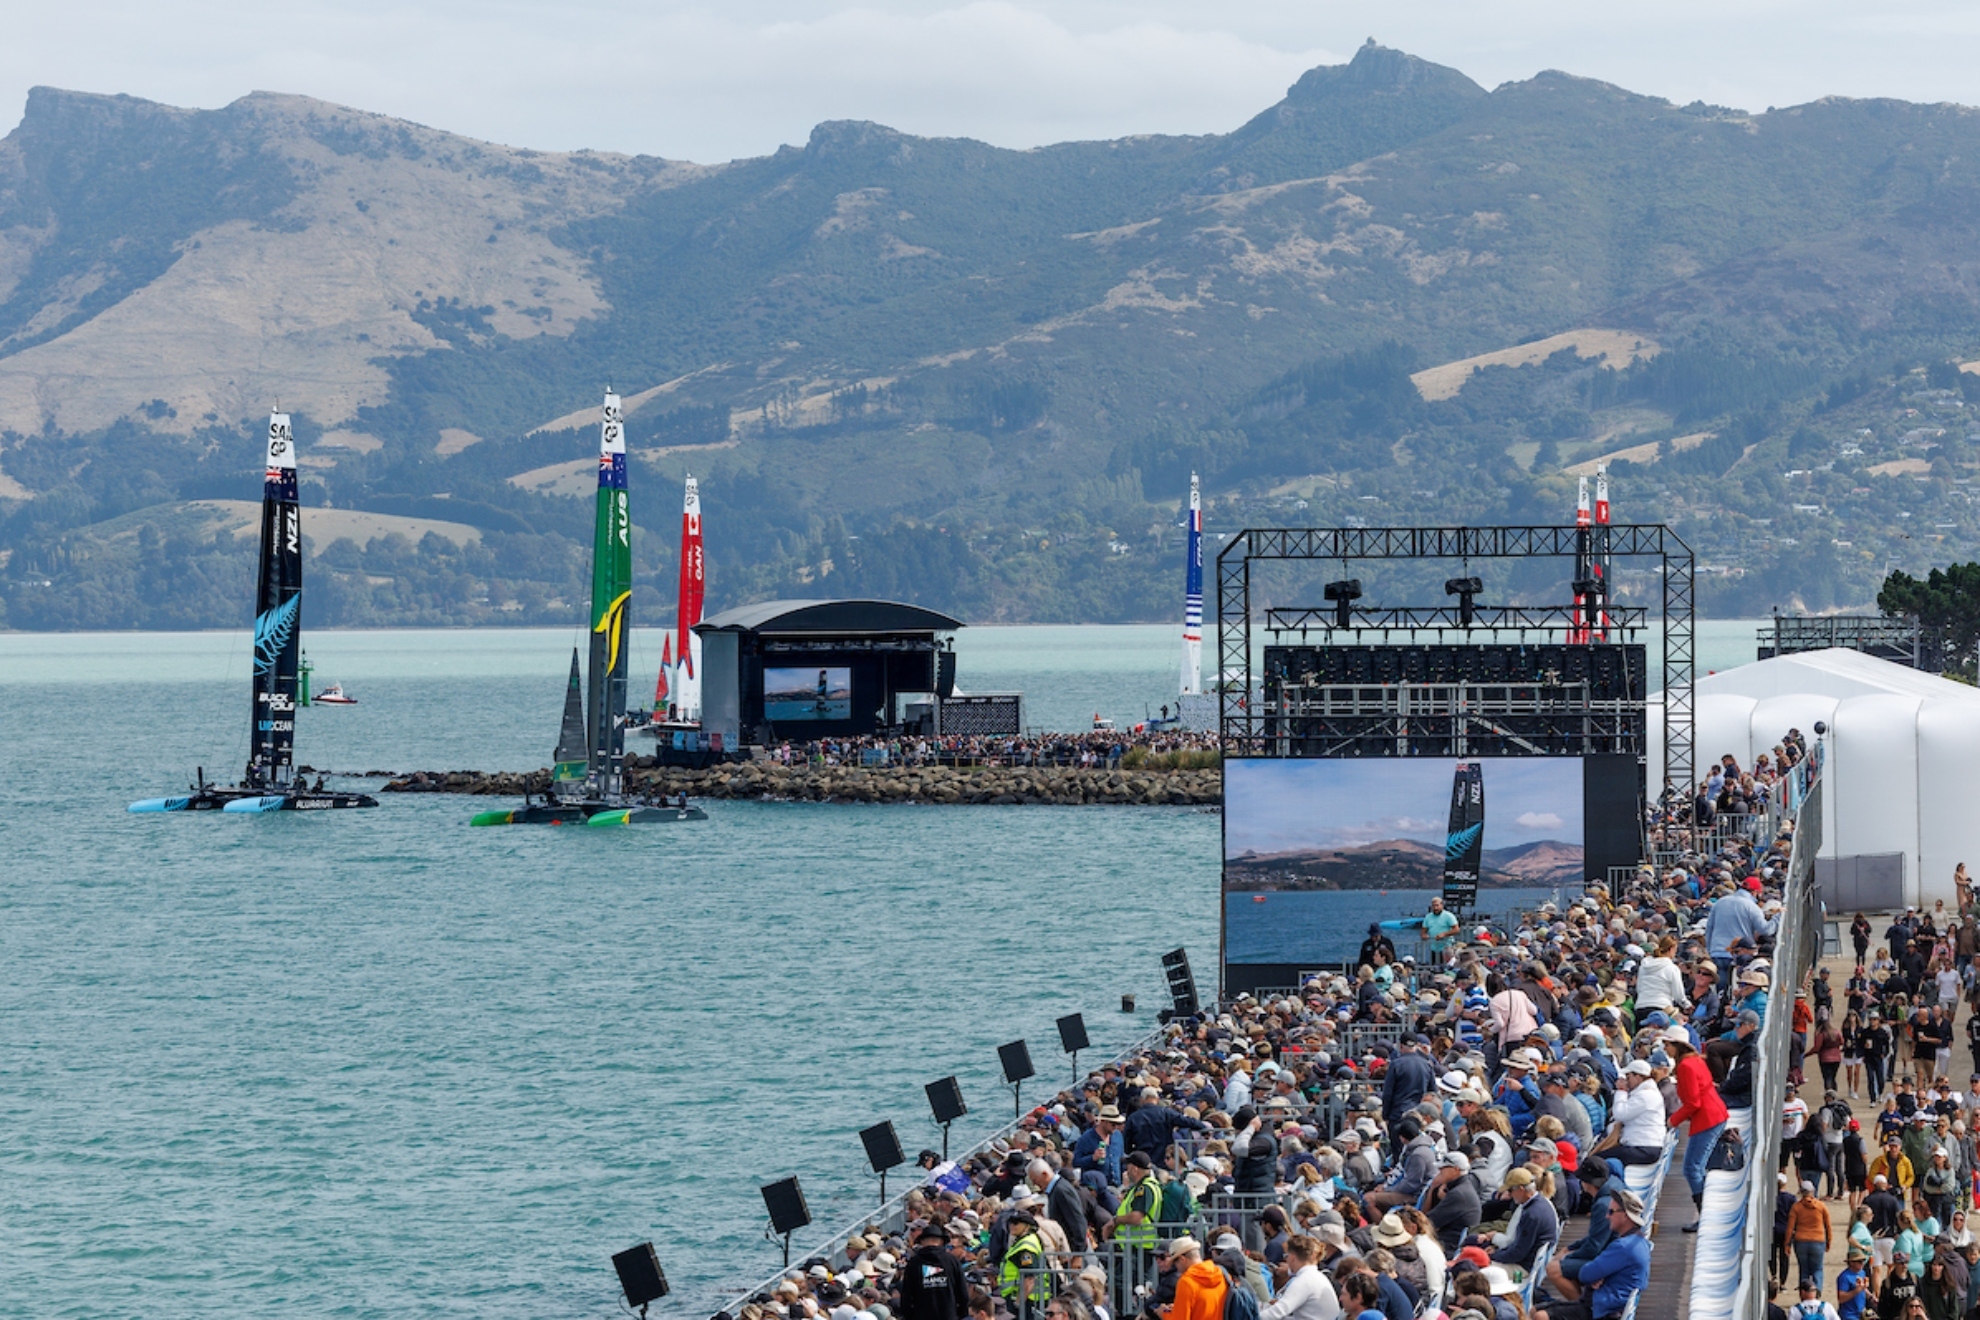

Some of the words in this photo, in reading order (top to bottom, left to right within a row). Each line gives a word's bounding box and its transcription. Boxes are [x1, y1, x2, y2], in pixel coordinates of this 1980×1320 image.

[270, 424, 293, 441] SAIL
[270, 442, 287, 457] GP
[618, 491, 628, 548] AUS
[287, 506, 298, 554] NZL
[259, 693, 288, 702] BLACK
[1471, 781, 1481, 804] NZL
